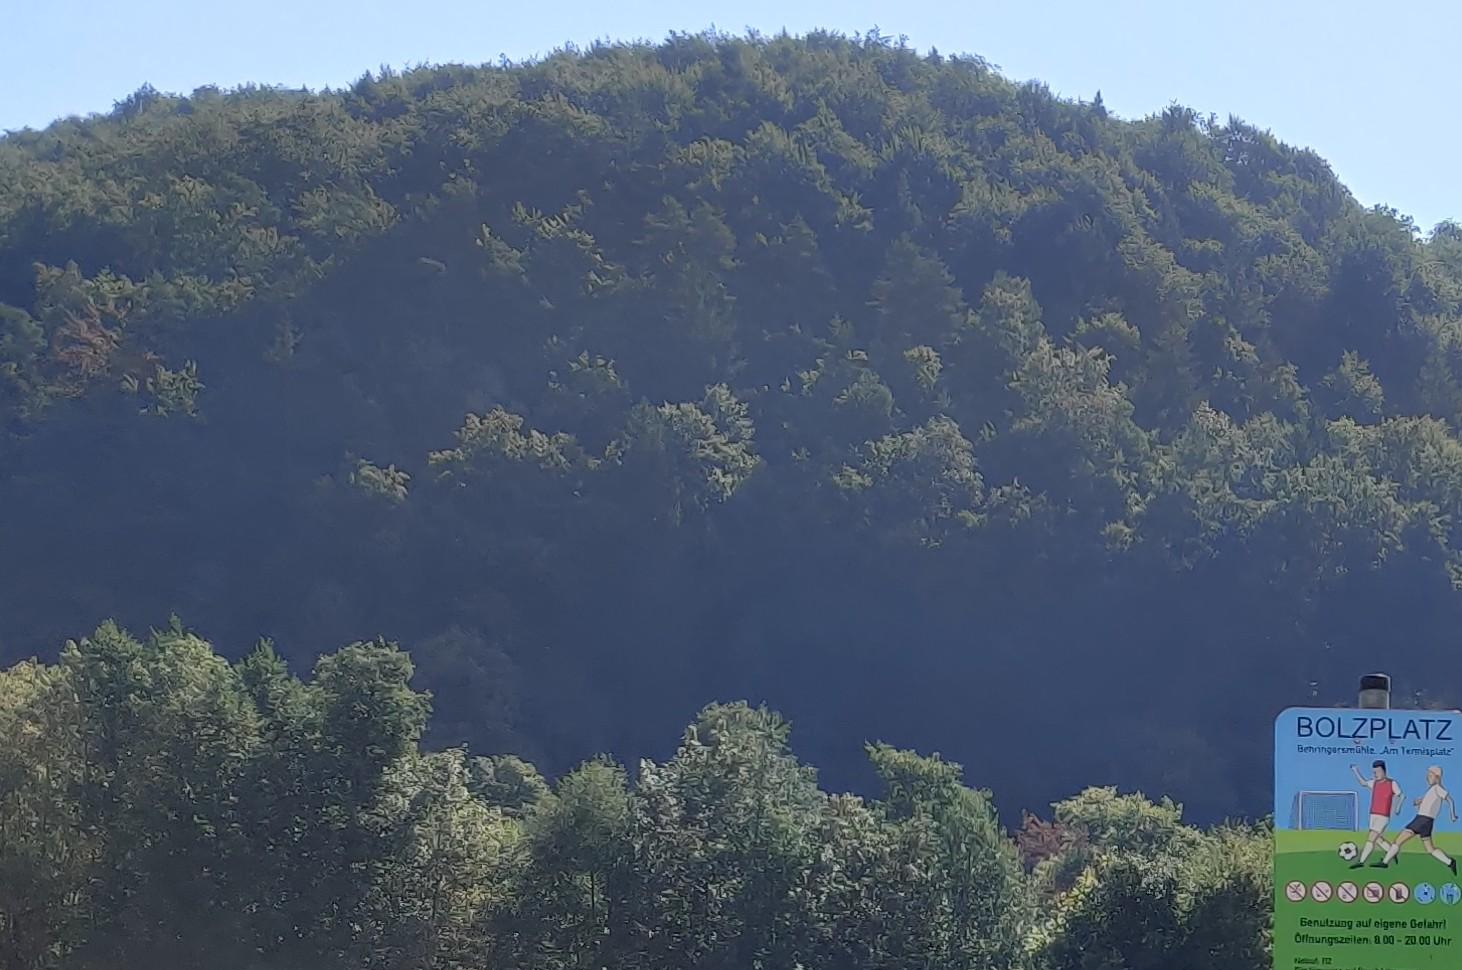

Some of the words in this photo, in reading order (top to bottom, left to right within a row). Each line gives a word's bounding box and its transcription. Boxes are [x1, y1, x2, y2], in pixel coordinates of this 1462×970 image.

[1297, 716, 1453, 740] BOLZPLATZ
[1300, 917, 1353, 930] Benutzung
[1356, 917, 1372, 928] auf
[1374, 919, 1408, 931] eigene
[1410, 918, 1446, 930] Gefahr!
[1433, 935, 1452, 947] Uhr
